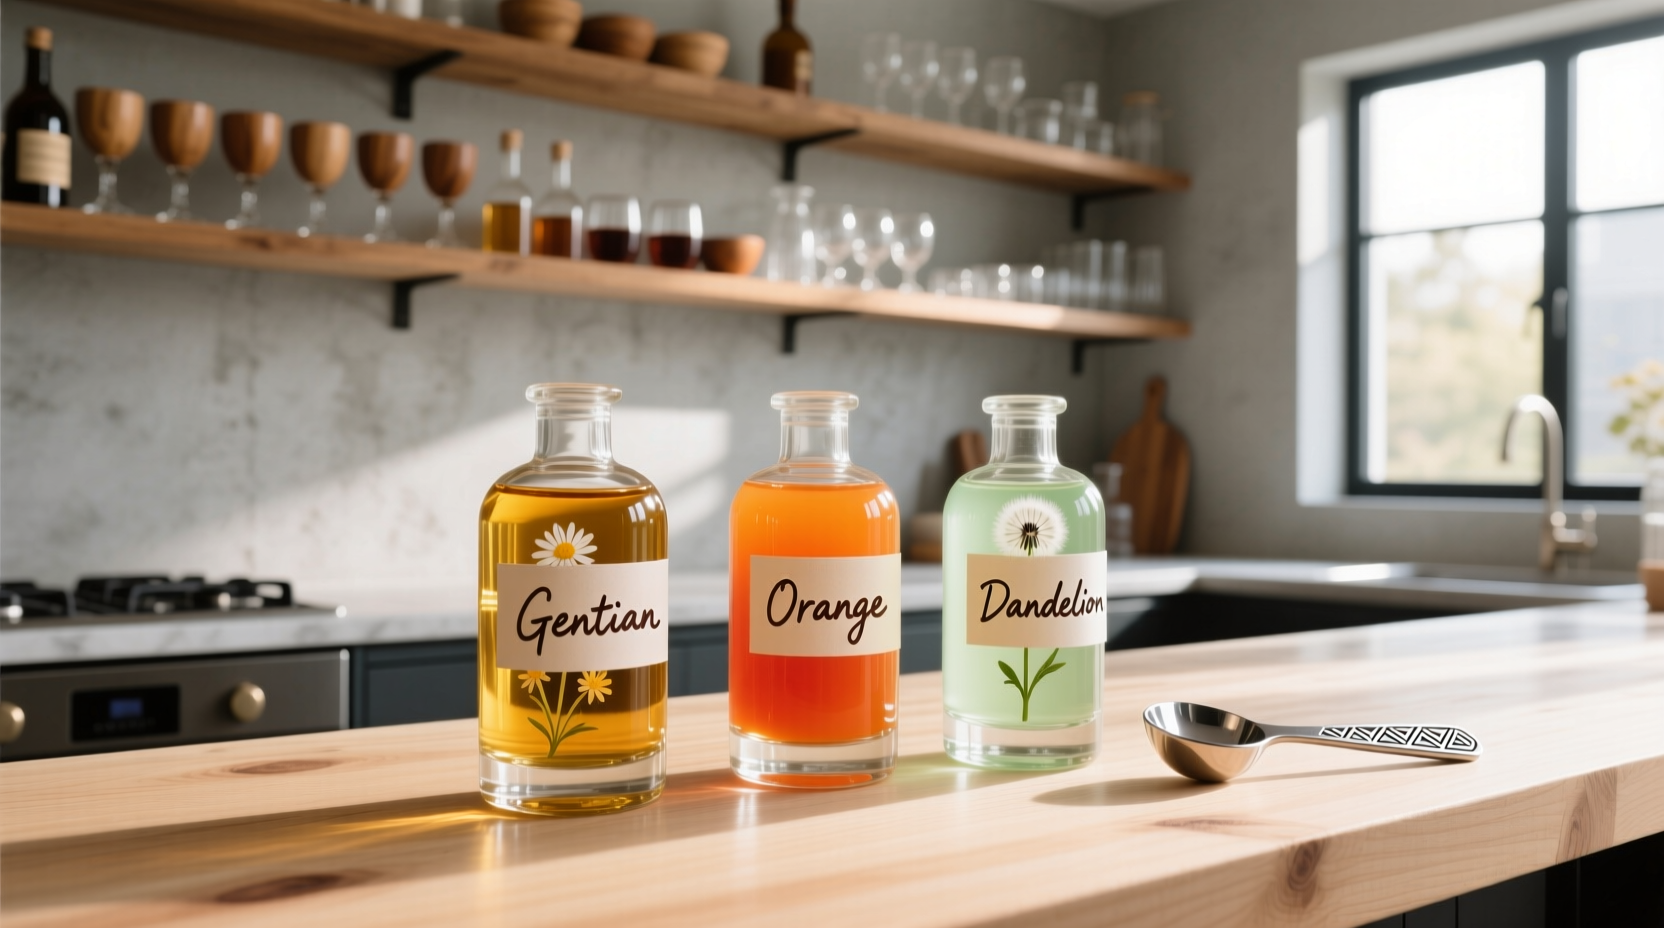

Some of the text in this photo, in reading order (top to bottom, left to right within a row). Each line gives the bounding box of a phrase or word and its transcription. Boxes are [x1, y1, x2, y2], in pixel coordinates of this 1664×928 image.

[516, 586, 661, 656] Gentian
[766, 578, 888, 645] Orange
[980, 578, 1104, 622] Dandelion
